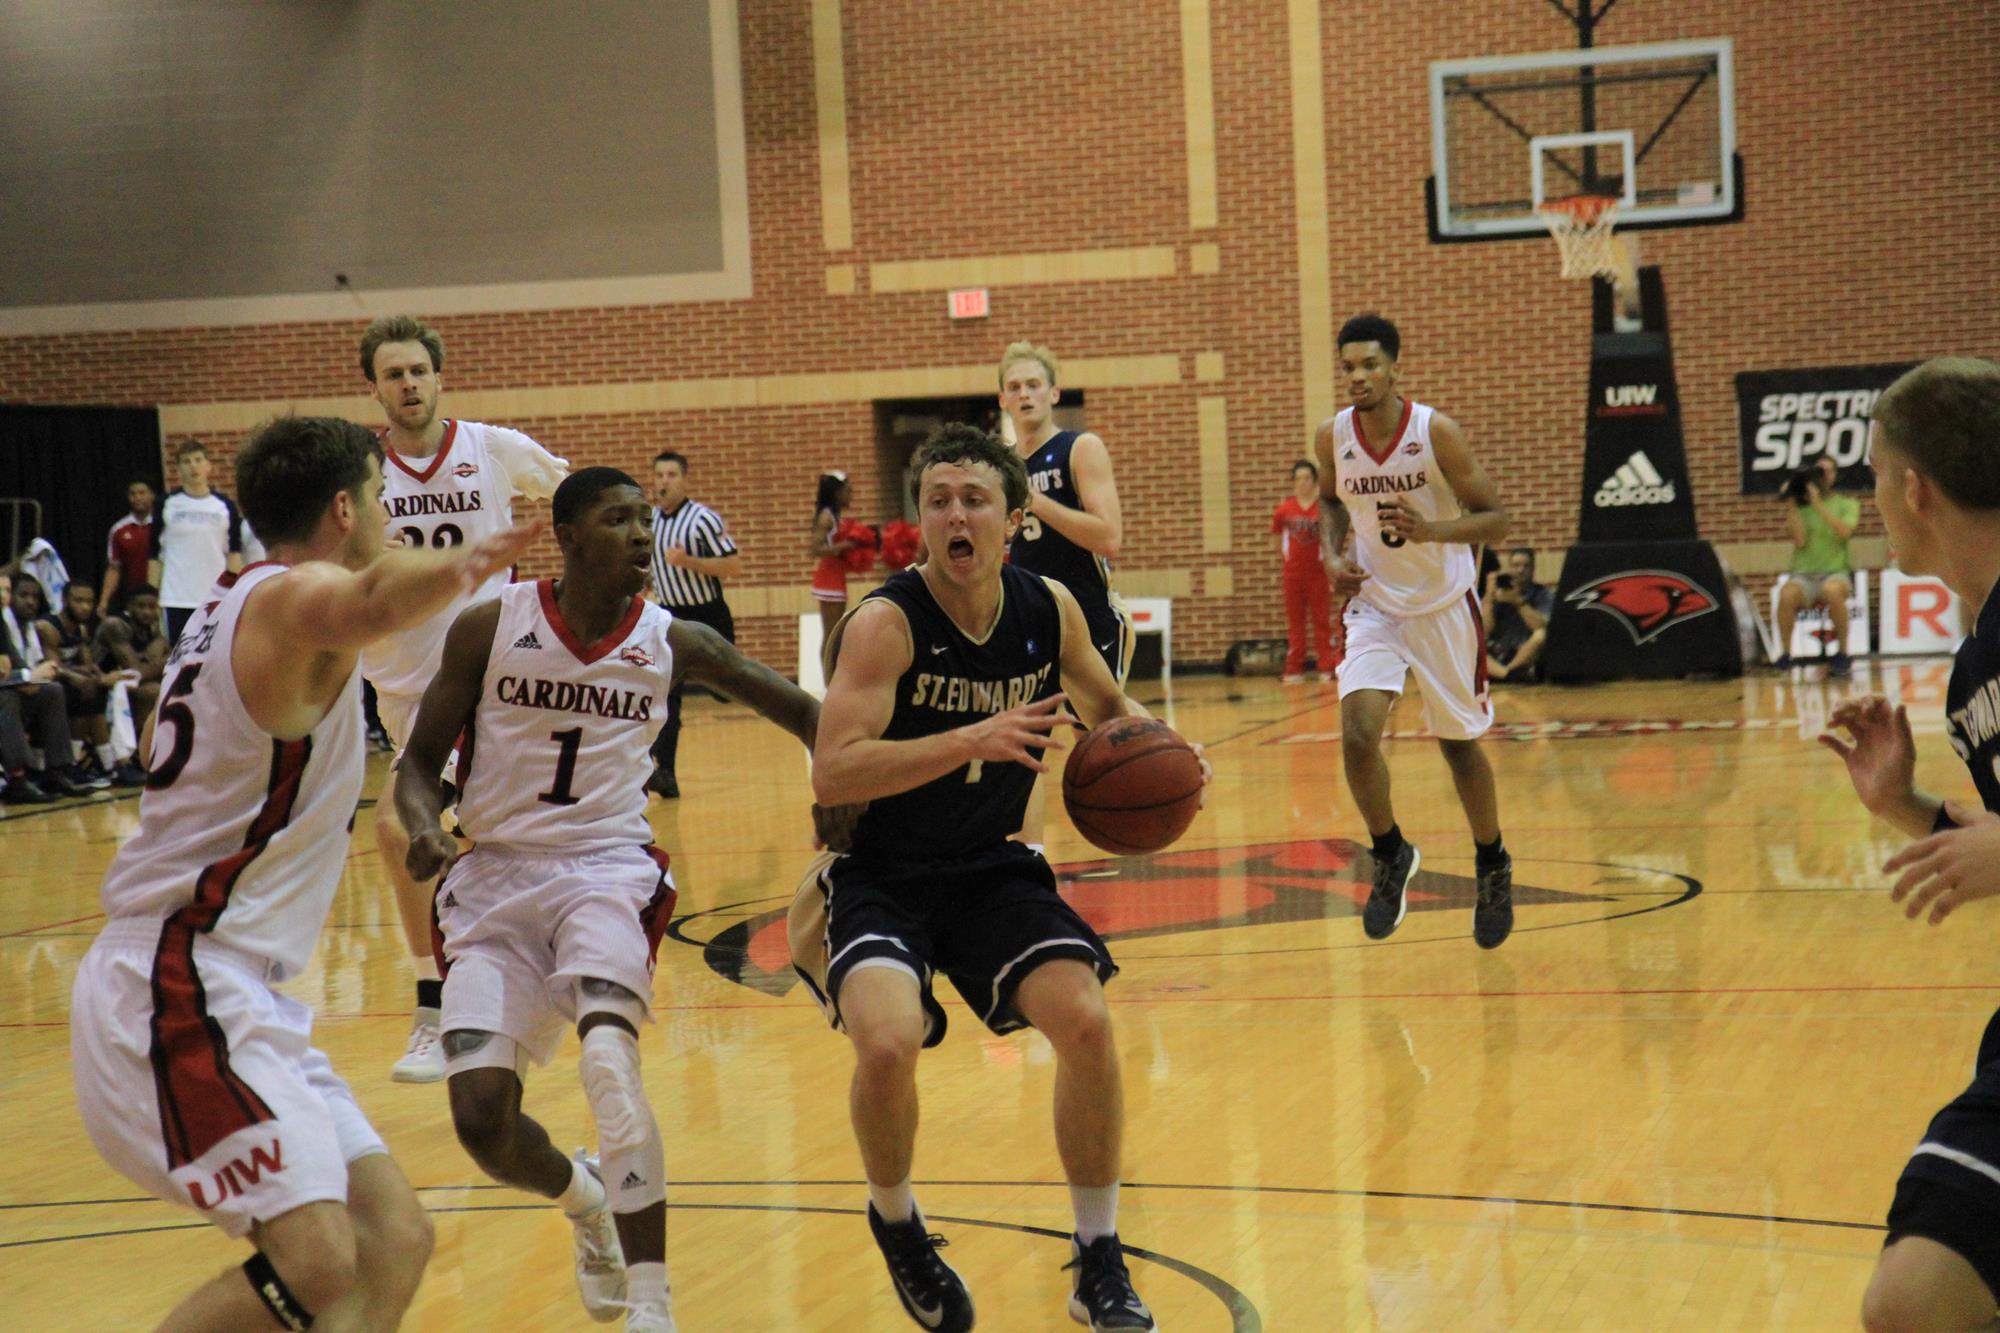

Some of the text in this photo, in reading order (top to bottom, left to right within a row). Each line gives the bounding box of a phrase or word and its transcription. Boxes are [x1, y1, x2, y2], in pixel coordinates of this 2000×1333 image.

[955, 291, 986, 316] EXIT
[1605, 384, 1657, 407] UIW
[1752, 416, 1877, 471] SPO
[1028, 468, 1063, 492] RD'S
[1344, 471, 1427, 495] CARDINALS
[384, 490, 481, 518] ARDINALS
[1594, 484, 1676, 507] adidas
[1897, 583, 1951, 638] R
[497, 676, 653, 722] CARDINALS
[537, 726, 583, 806] 1
[187, 1138, 282, 1211] UIW
